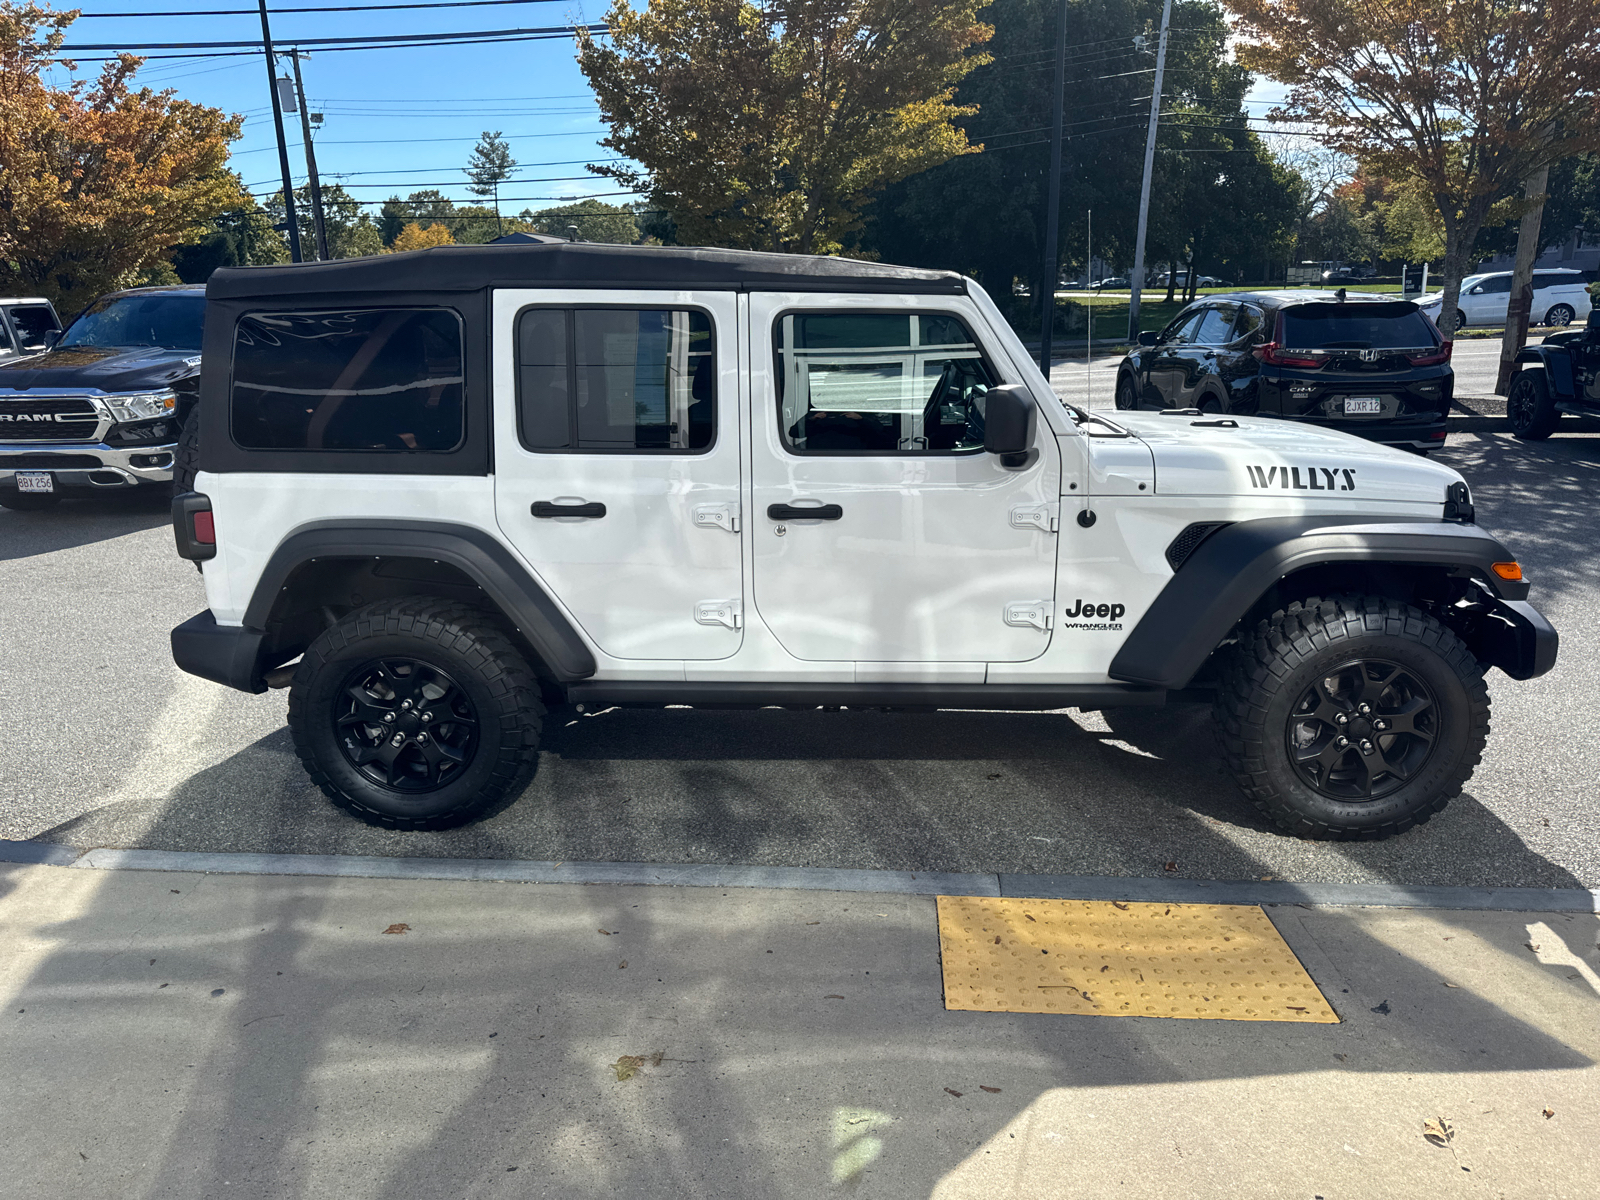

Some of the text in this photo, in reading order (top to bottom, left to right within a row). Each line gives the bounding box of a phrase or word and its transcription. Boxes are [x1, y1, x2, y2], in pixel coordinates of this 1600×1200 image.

[1346, 401, 1380, 412] 2JXR 12
[0, 413, 53, 422] RAM
[17, 477, 52, 488] 8BX 256
[1246, 465, 1356, 491] WILLYS
[1065, 599, 1126, 621] Jeep
